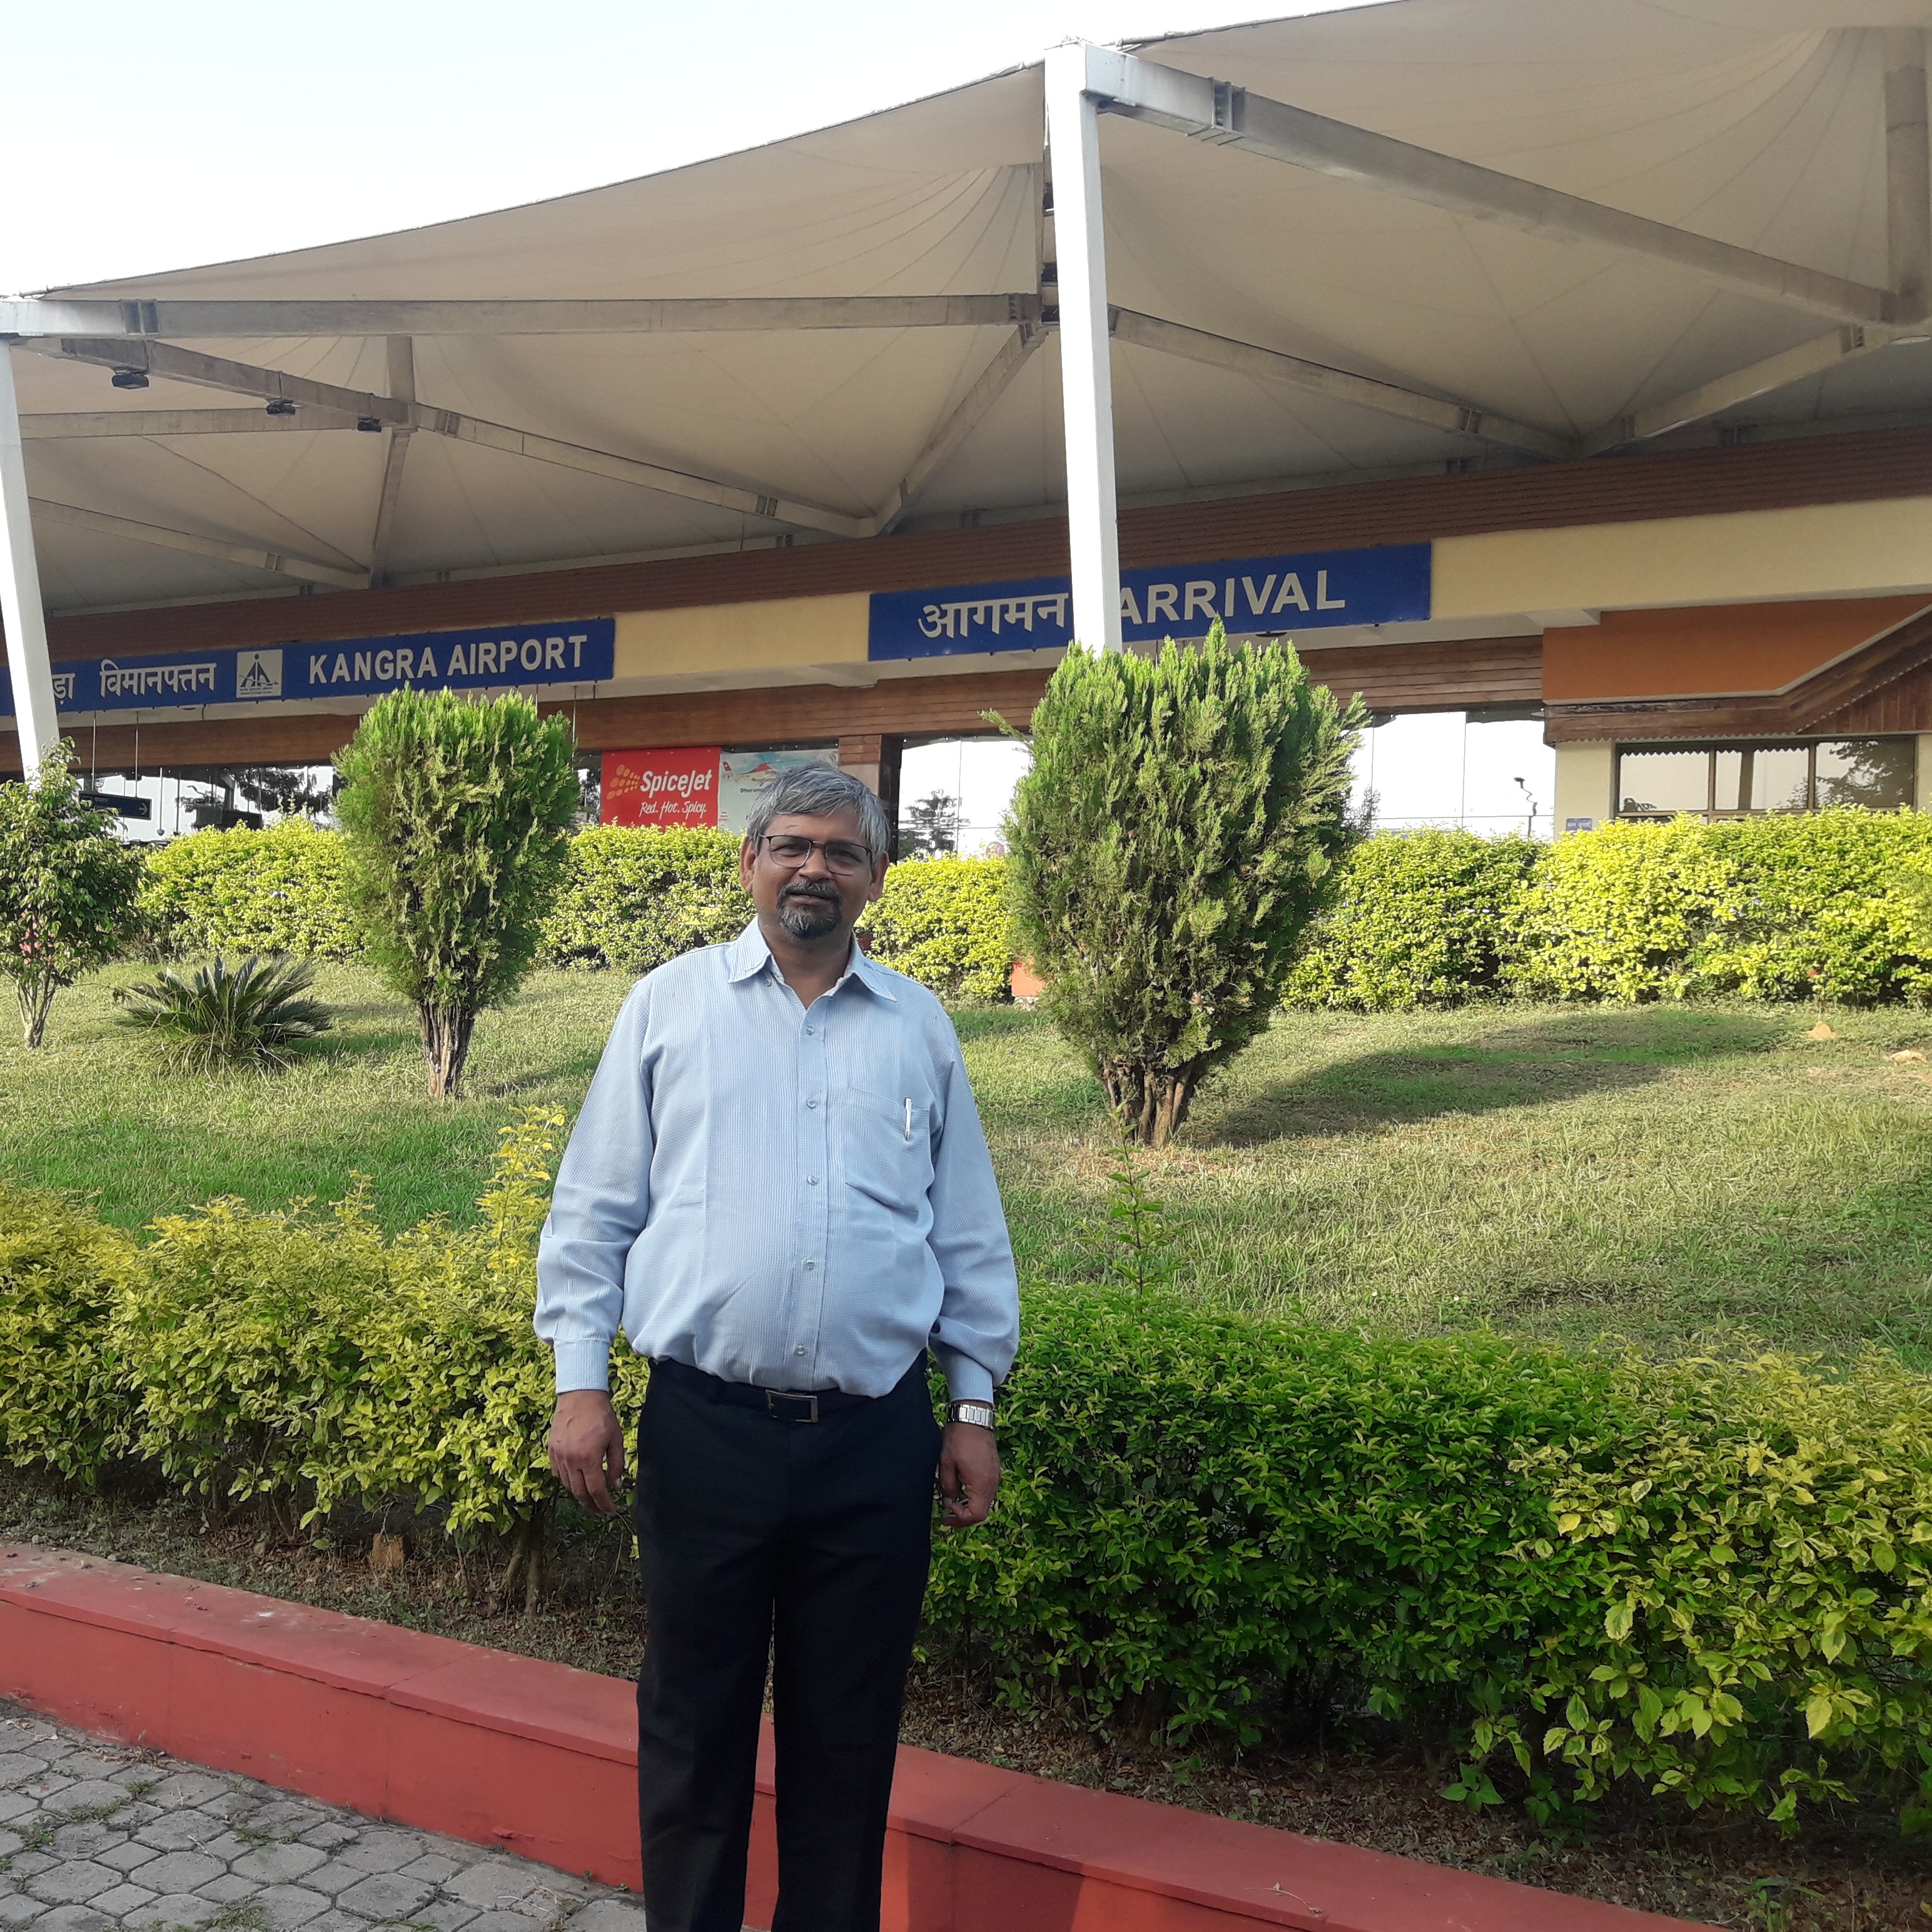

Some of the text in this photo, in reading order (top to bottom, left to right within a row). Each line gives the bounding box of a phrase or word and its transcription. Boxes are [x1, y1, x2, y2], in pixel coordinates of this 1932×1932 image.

[918, 593, 1068, 639] आगमन
[1120, 570, 1345, 625] ARRIVAL
[99, 658, 217, 697] विमानपत्तन
[309, 635, 587, 684] KANGRA AIRPORT
[640, 769, 712, 799] SpiceJet
[639, 801, 659, 818] Red.
[659, 801, 680, 820] Hot.
[682, 801, 707, 820] Spicy.
